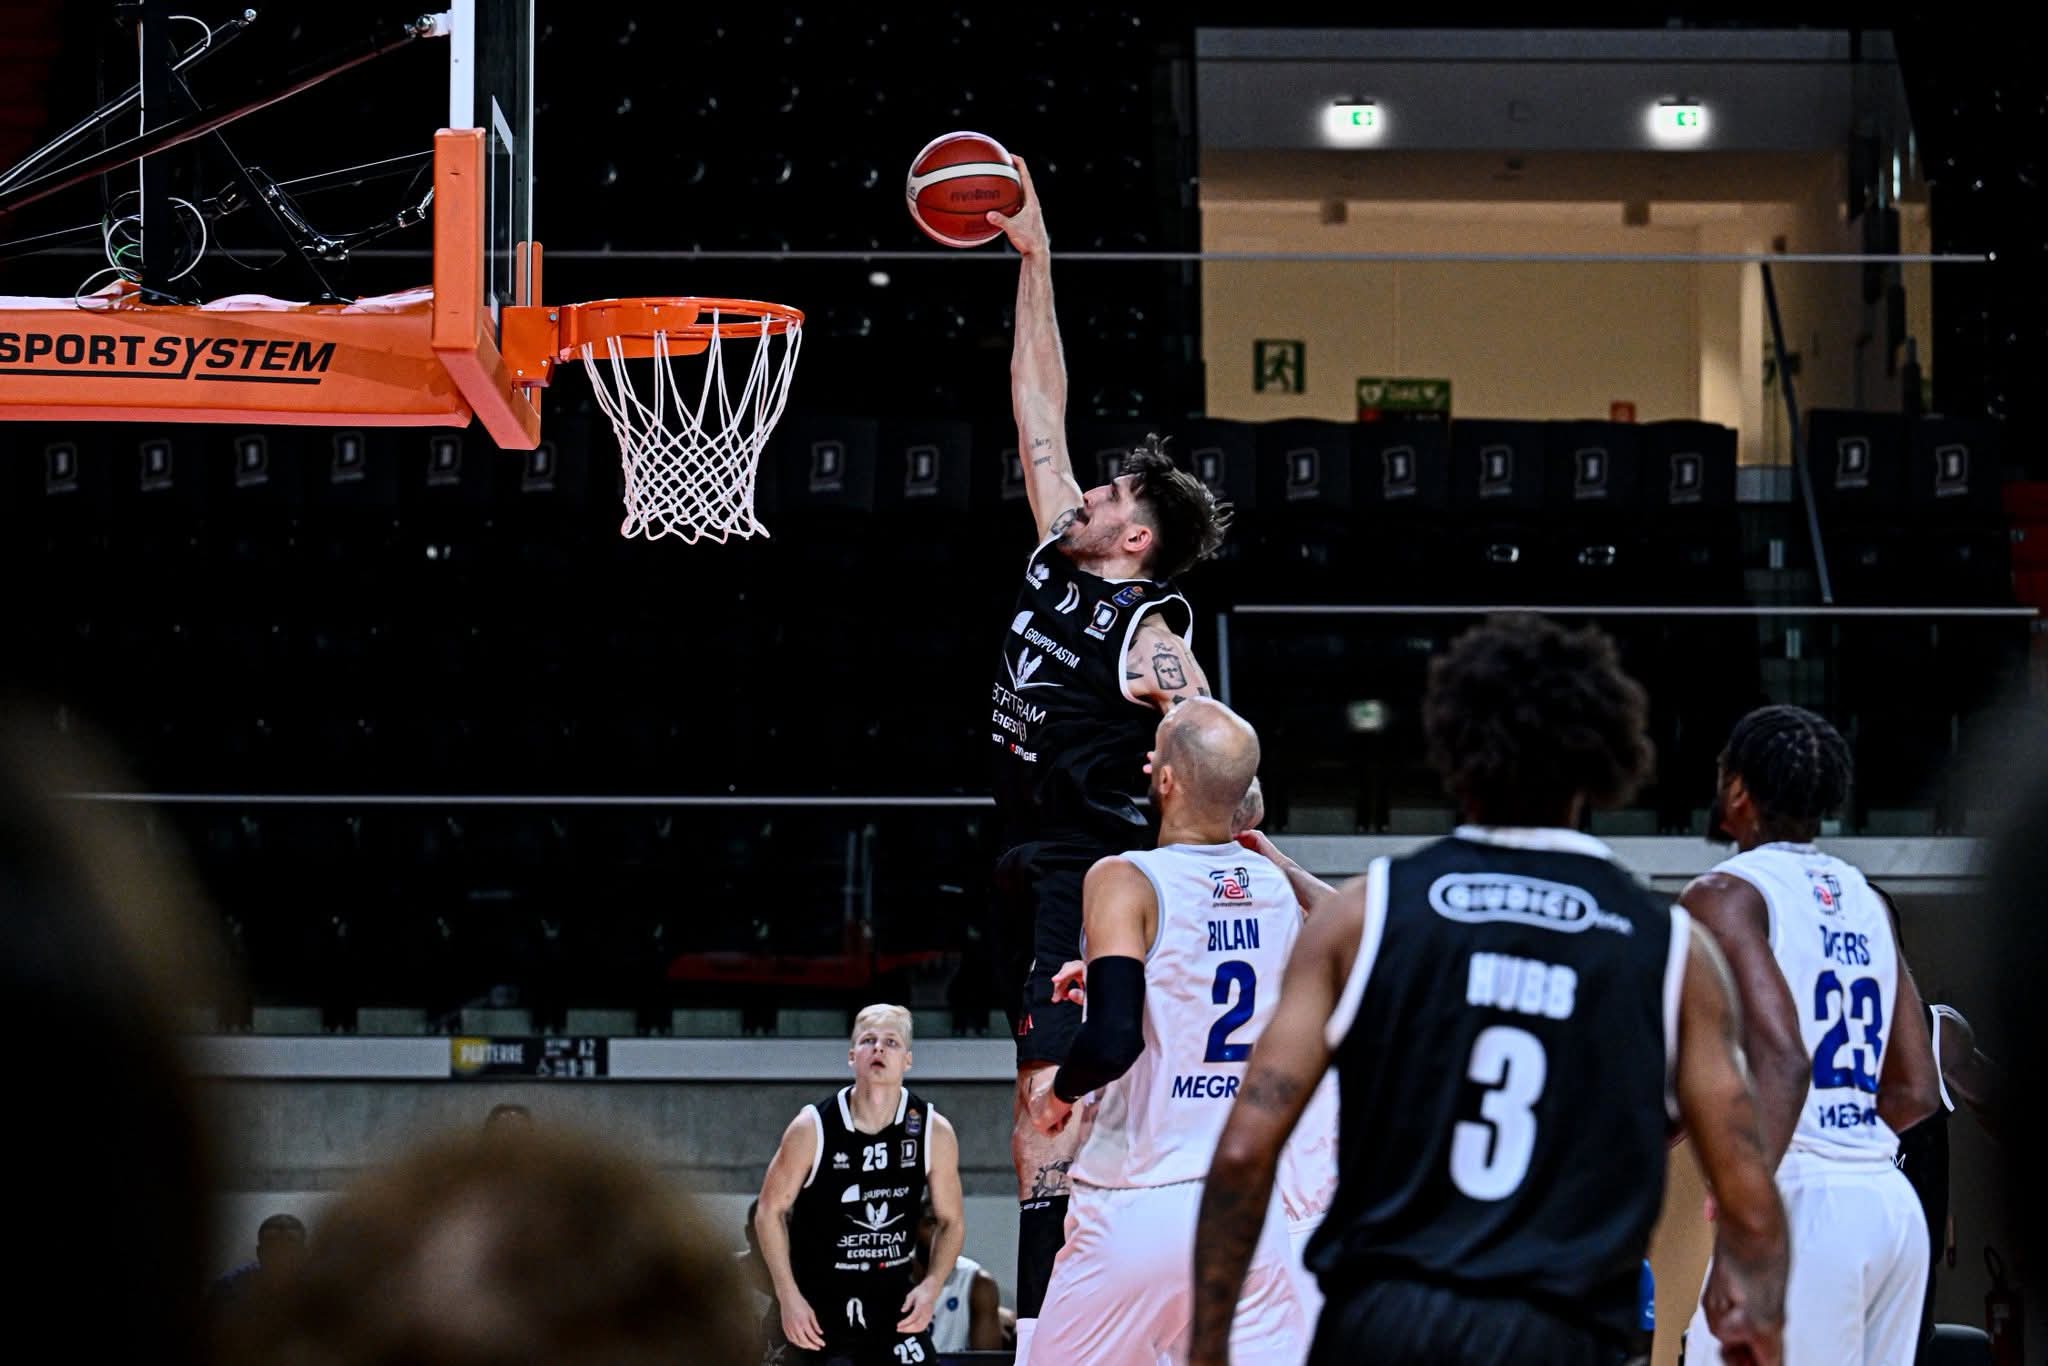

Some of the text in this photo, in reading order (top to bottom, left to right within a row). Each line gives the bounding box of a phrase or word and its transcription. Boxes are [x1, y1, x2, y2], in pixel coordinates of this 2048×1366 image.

[0, 333, 336, 380] SPORT SYSTEM
[1024, 627, 1058, 656] GRUPPO
[1053, 646, 1081, 670] ASTM
[1207, 918, 1260, 952] BILAN
[1203, 960, 1257, 1063] 2
[1812, 970, 1883, 1094] 23
[1449, 1025, 1548, 1201] 3
[862, 1142, 888, 1172] 25
[847, 1248, 887, 1258] ECOGEST
[893, 1336, 925, 1364] 25
